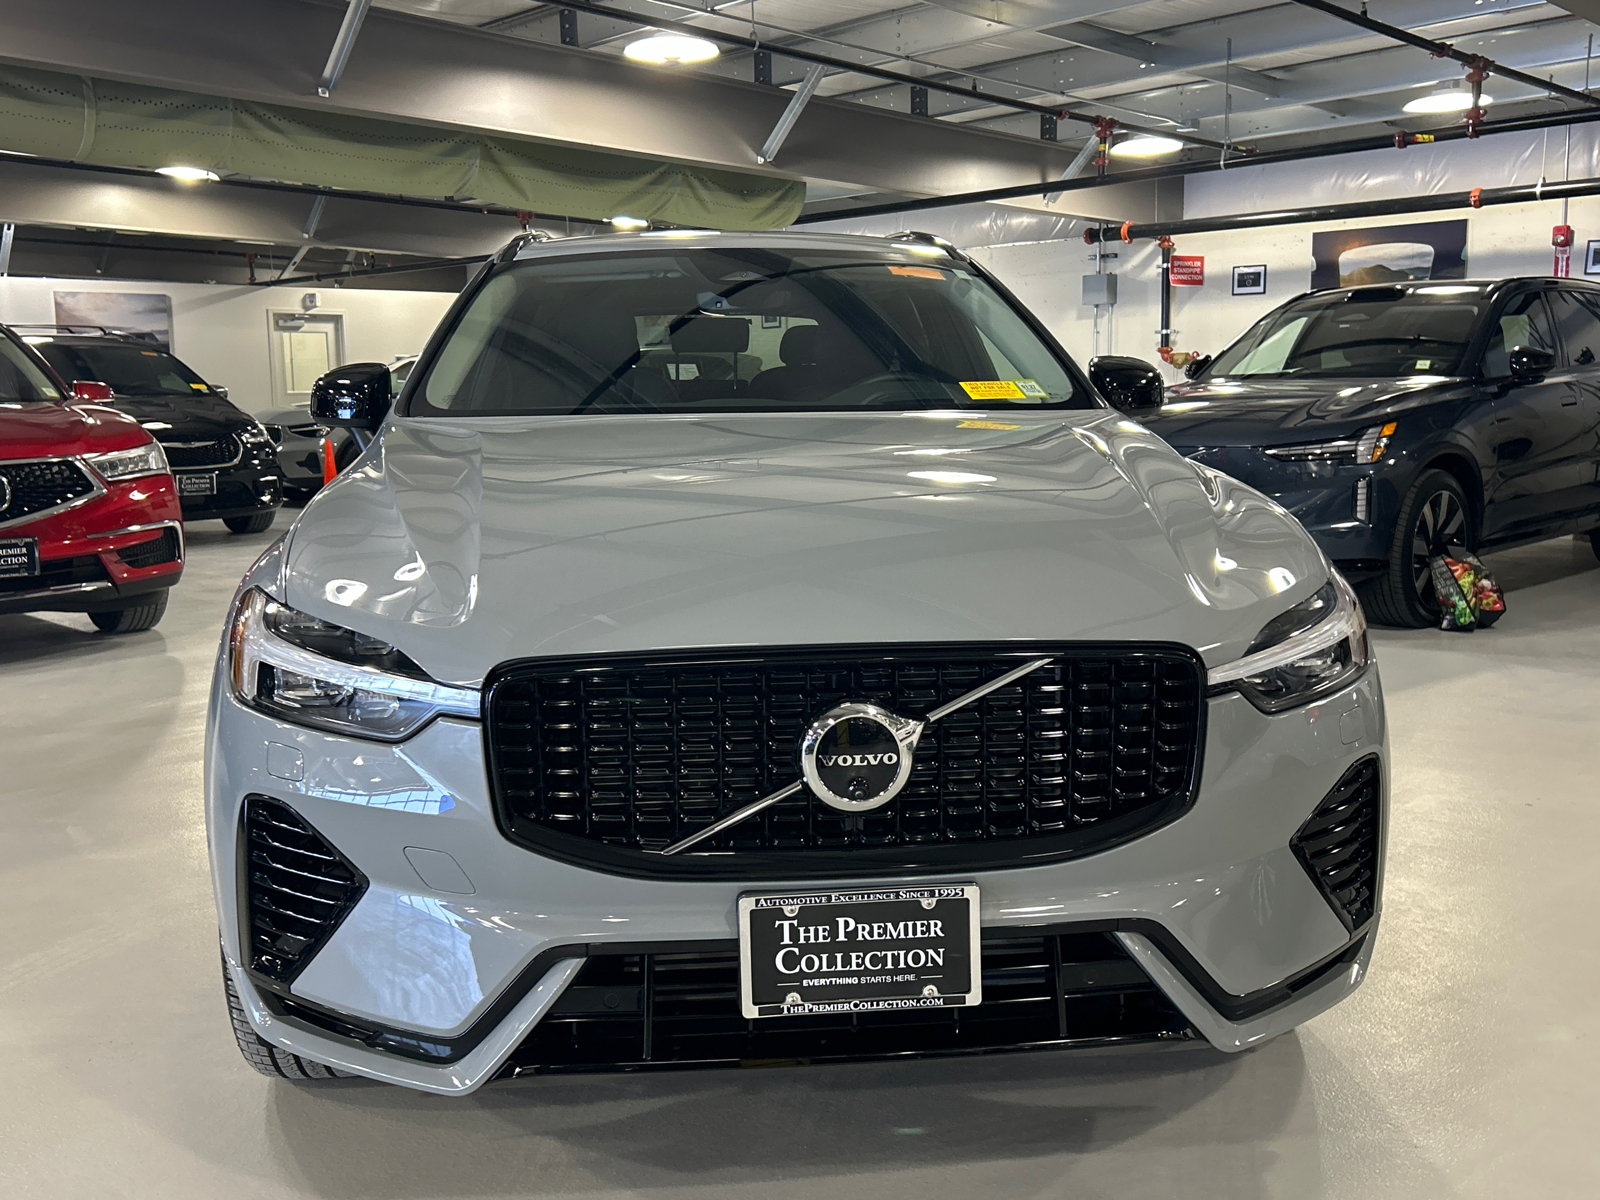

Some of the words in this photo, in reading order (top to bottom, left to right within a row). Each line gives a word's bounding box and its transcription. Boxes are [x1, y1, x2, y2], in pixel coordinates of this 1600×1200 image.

[0, 547, 27, 556] REMIER
[819, 753, 898, 767] VOLVO
[757, 896, 828, 907] AUTOMOTIVE
[831, 893, 896, 903] EXCELLENCE
[899, 890, 930, 900] SINCE
[934, 888, 963, 898] 1995
[774, 919, 831, 945] THE
[835, 917, 945, 942] PREMIER
[775, 948, 946, 974] COLLECTION
[802, 977, 859, 987] EVERYTHING
[860, 975, 892, 984] STARTS
[893, 974, 918, 982] HERE.
[780, 998, 944, 1015] THEPREMIERCOLLECTION.COM
